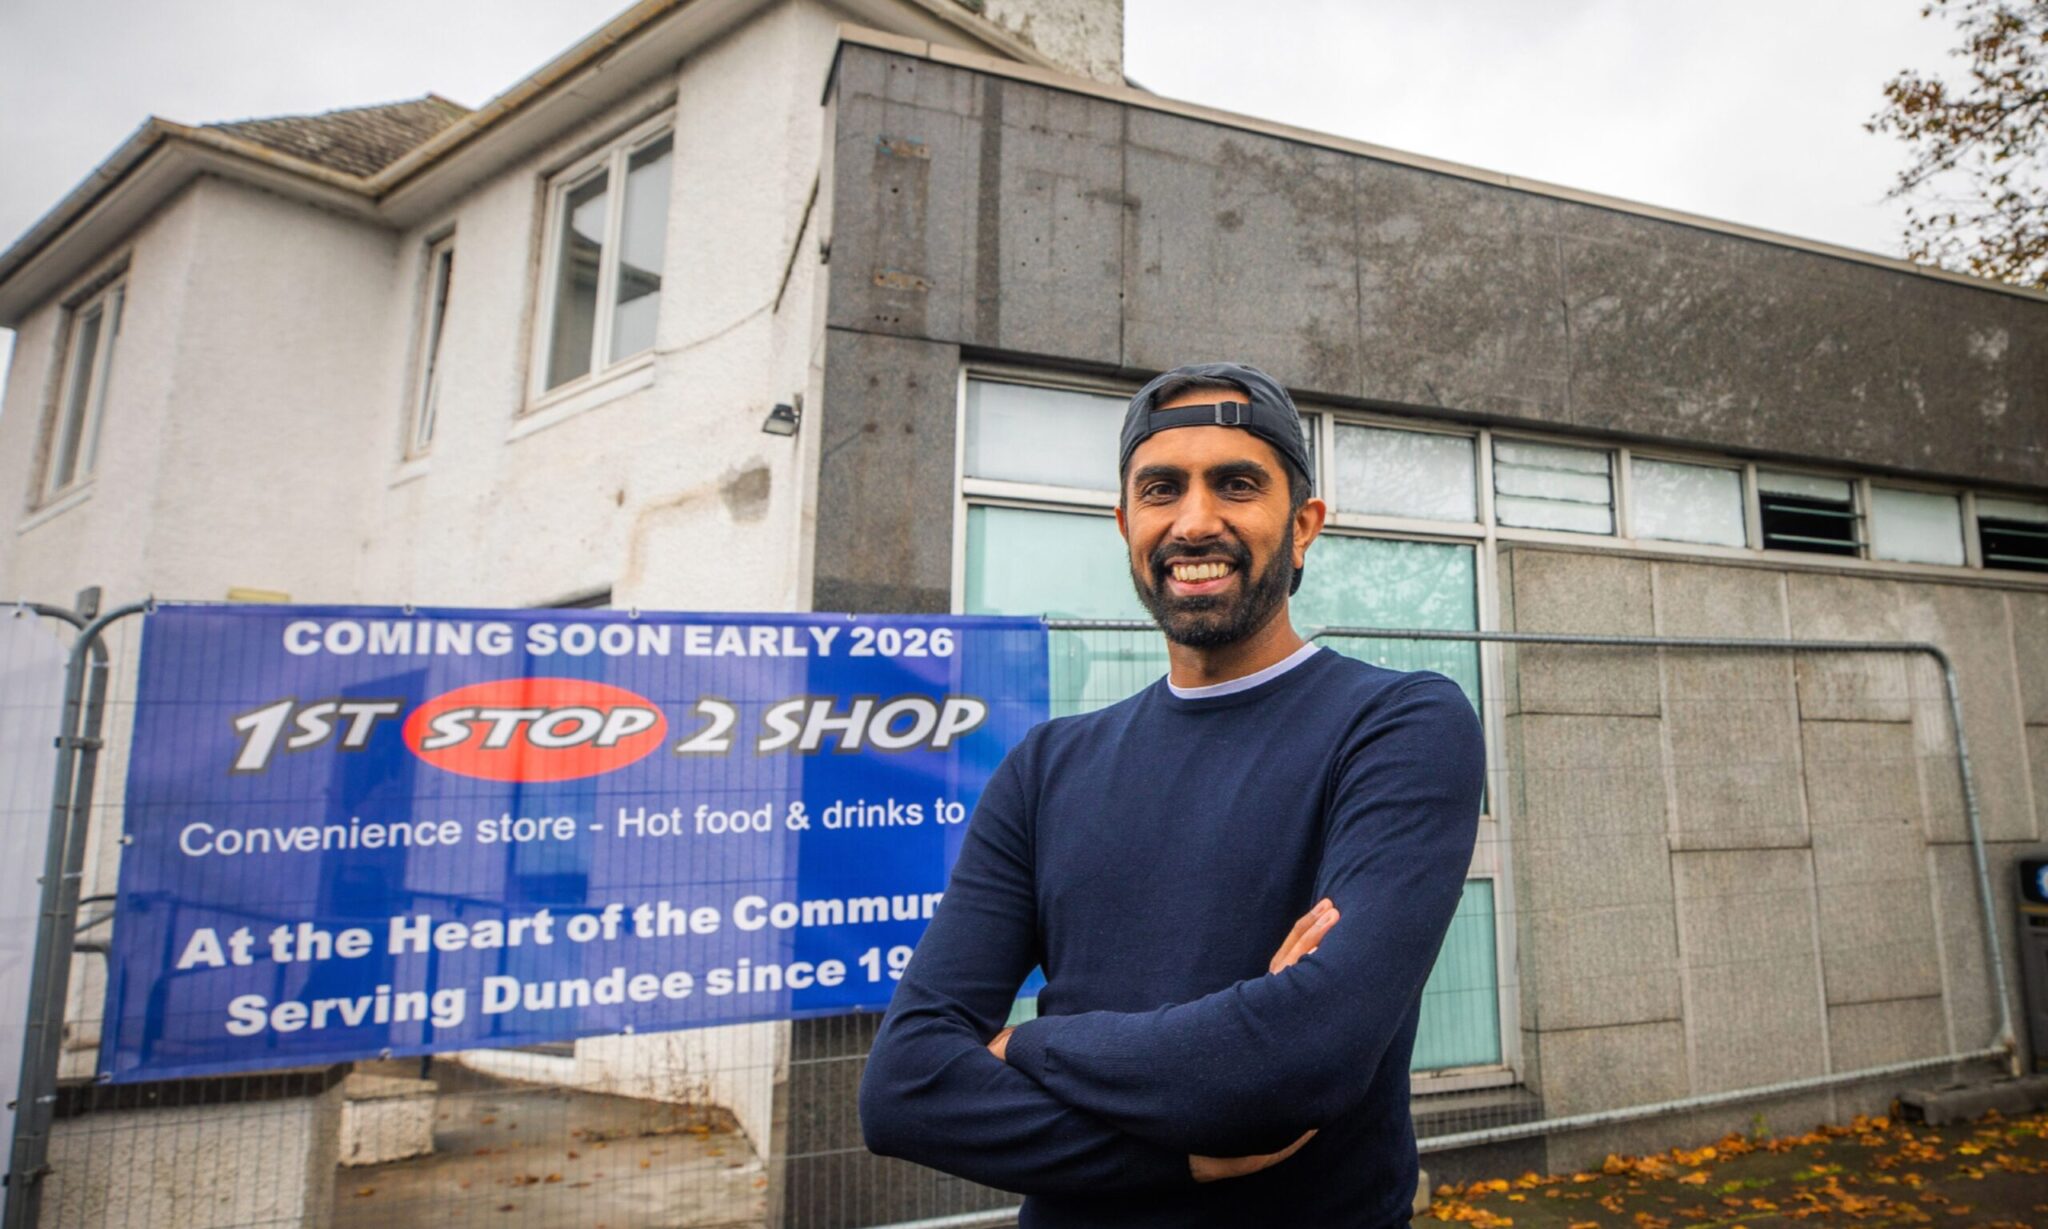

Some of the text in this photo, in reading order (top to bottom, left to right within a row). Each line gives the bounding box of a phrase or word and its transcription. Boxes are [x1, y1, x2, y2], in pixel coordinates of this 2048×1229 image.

[283, 621, 955, 657] COMING SOON EARLY 2026
[230, 694, 988, 774] 1ST STOP 2 SHOP
[179, 816, 461, 857] Convenience
[476, 812, 576, 844] store
[617, 806, 683, 838] Hot
[695, 803, 773, 834] food
[785, 802, 810, 831] &
[822, 798, 923, 829] drinks
[934, 797, 966, 825] to
[177, 926, 254, 969] At
[270, 922, 372, 962] the
[388, 908, 554, 955] Heart
[566, 905, 624, 943] of
[632, 900, 721, 938] the
[226, 985, 466, 1036] Serving
[482, 968, 693, 1014] Dundee
[706, 959, 846, 996] since
